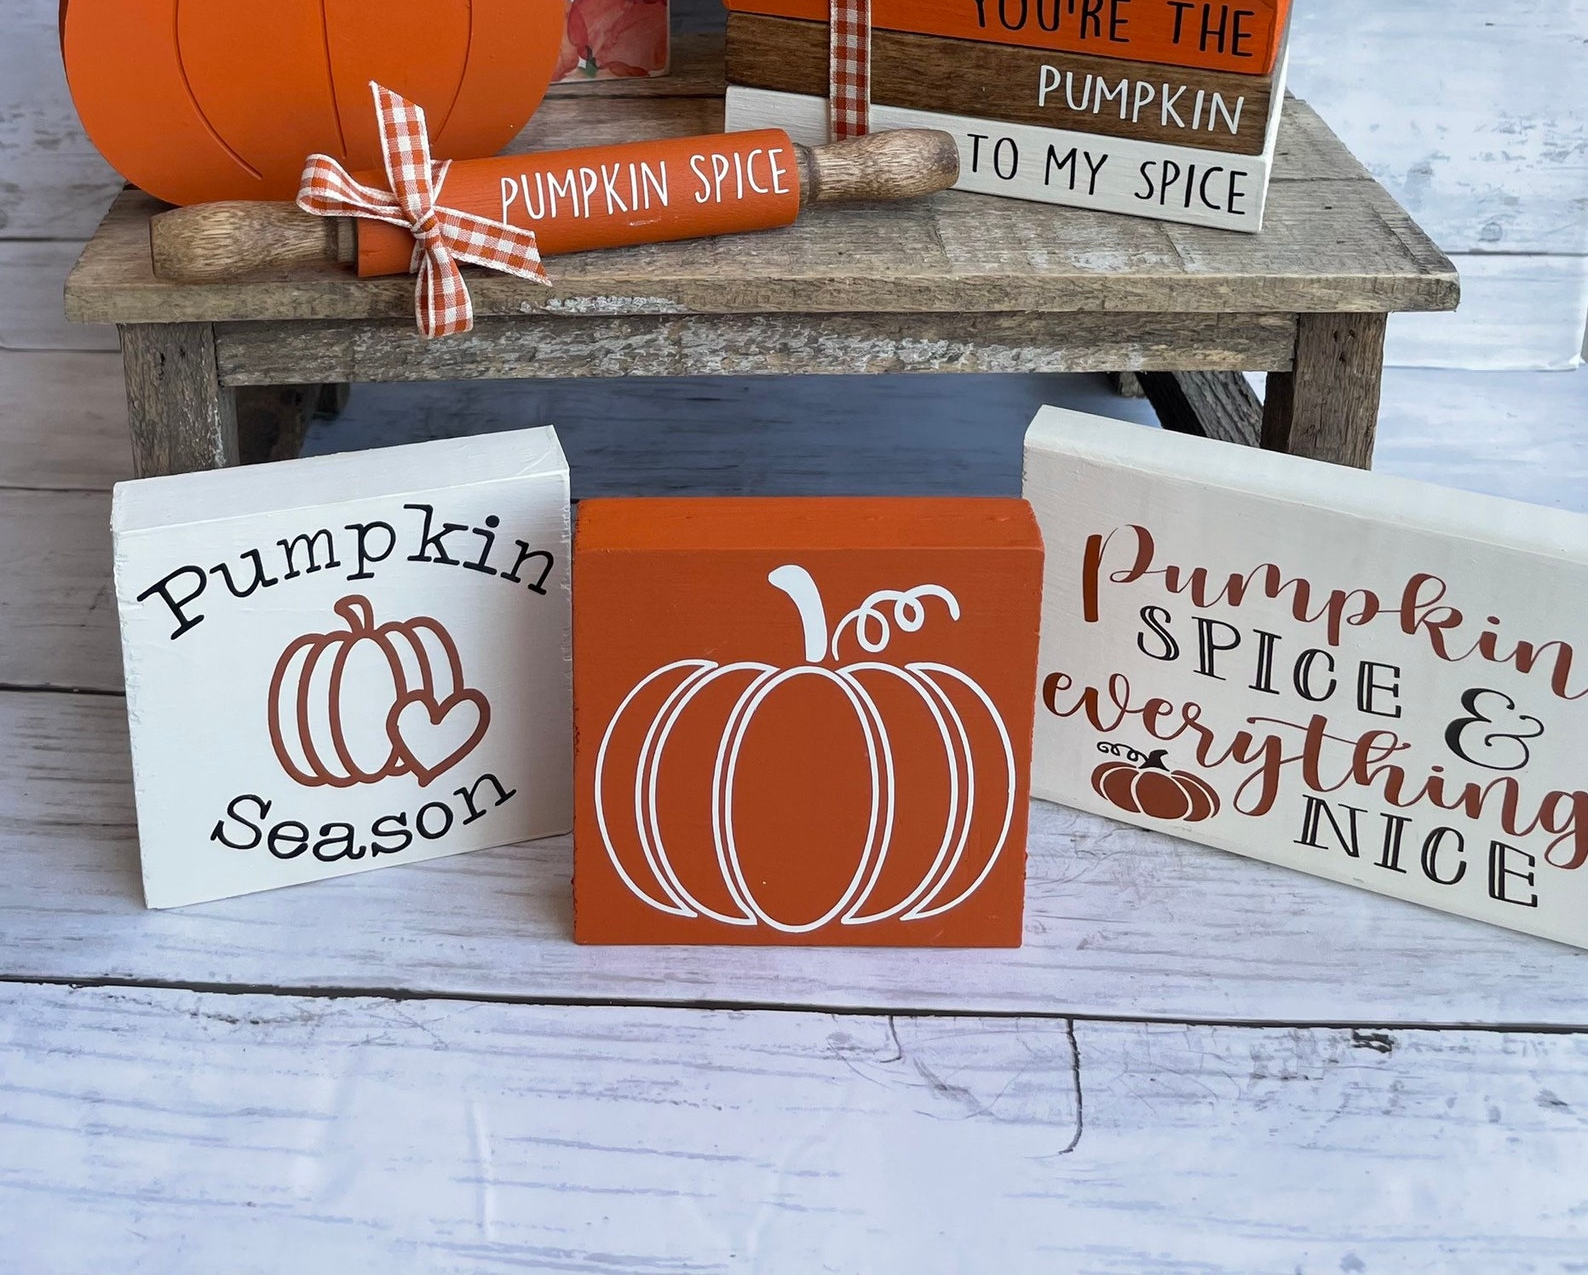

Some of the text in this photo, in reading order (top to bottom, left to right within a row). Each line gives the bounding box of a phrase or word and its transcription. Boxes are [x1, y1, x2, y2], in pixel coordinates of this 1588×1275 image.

[1166, 0, 1256, 58] THE
[1037, 64, 1245, 135] PUMPKIN
[500, 147, 791, 226] PUMPKIN SPICE
[966, 132, 1249, 215] TO MY SPICE
[136, 503, 555, 641] Pumpkin
[1082, 523, 1588, 700] Pumpkin
[1136, 604, 1546, 771] SPICE &
[210, 771, 518, 862] Season
[1041, 670, 1588, 870] everything
[1292, 793, 1539, 908] NICE
